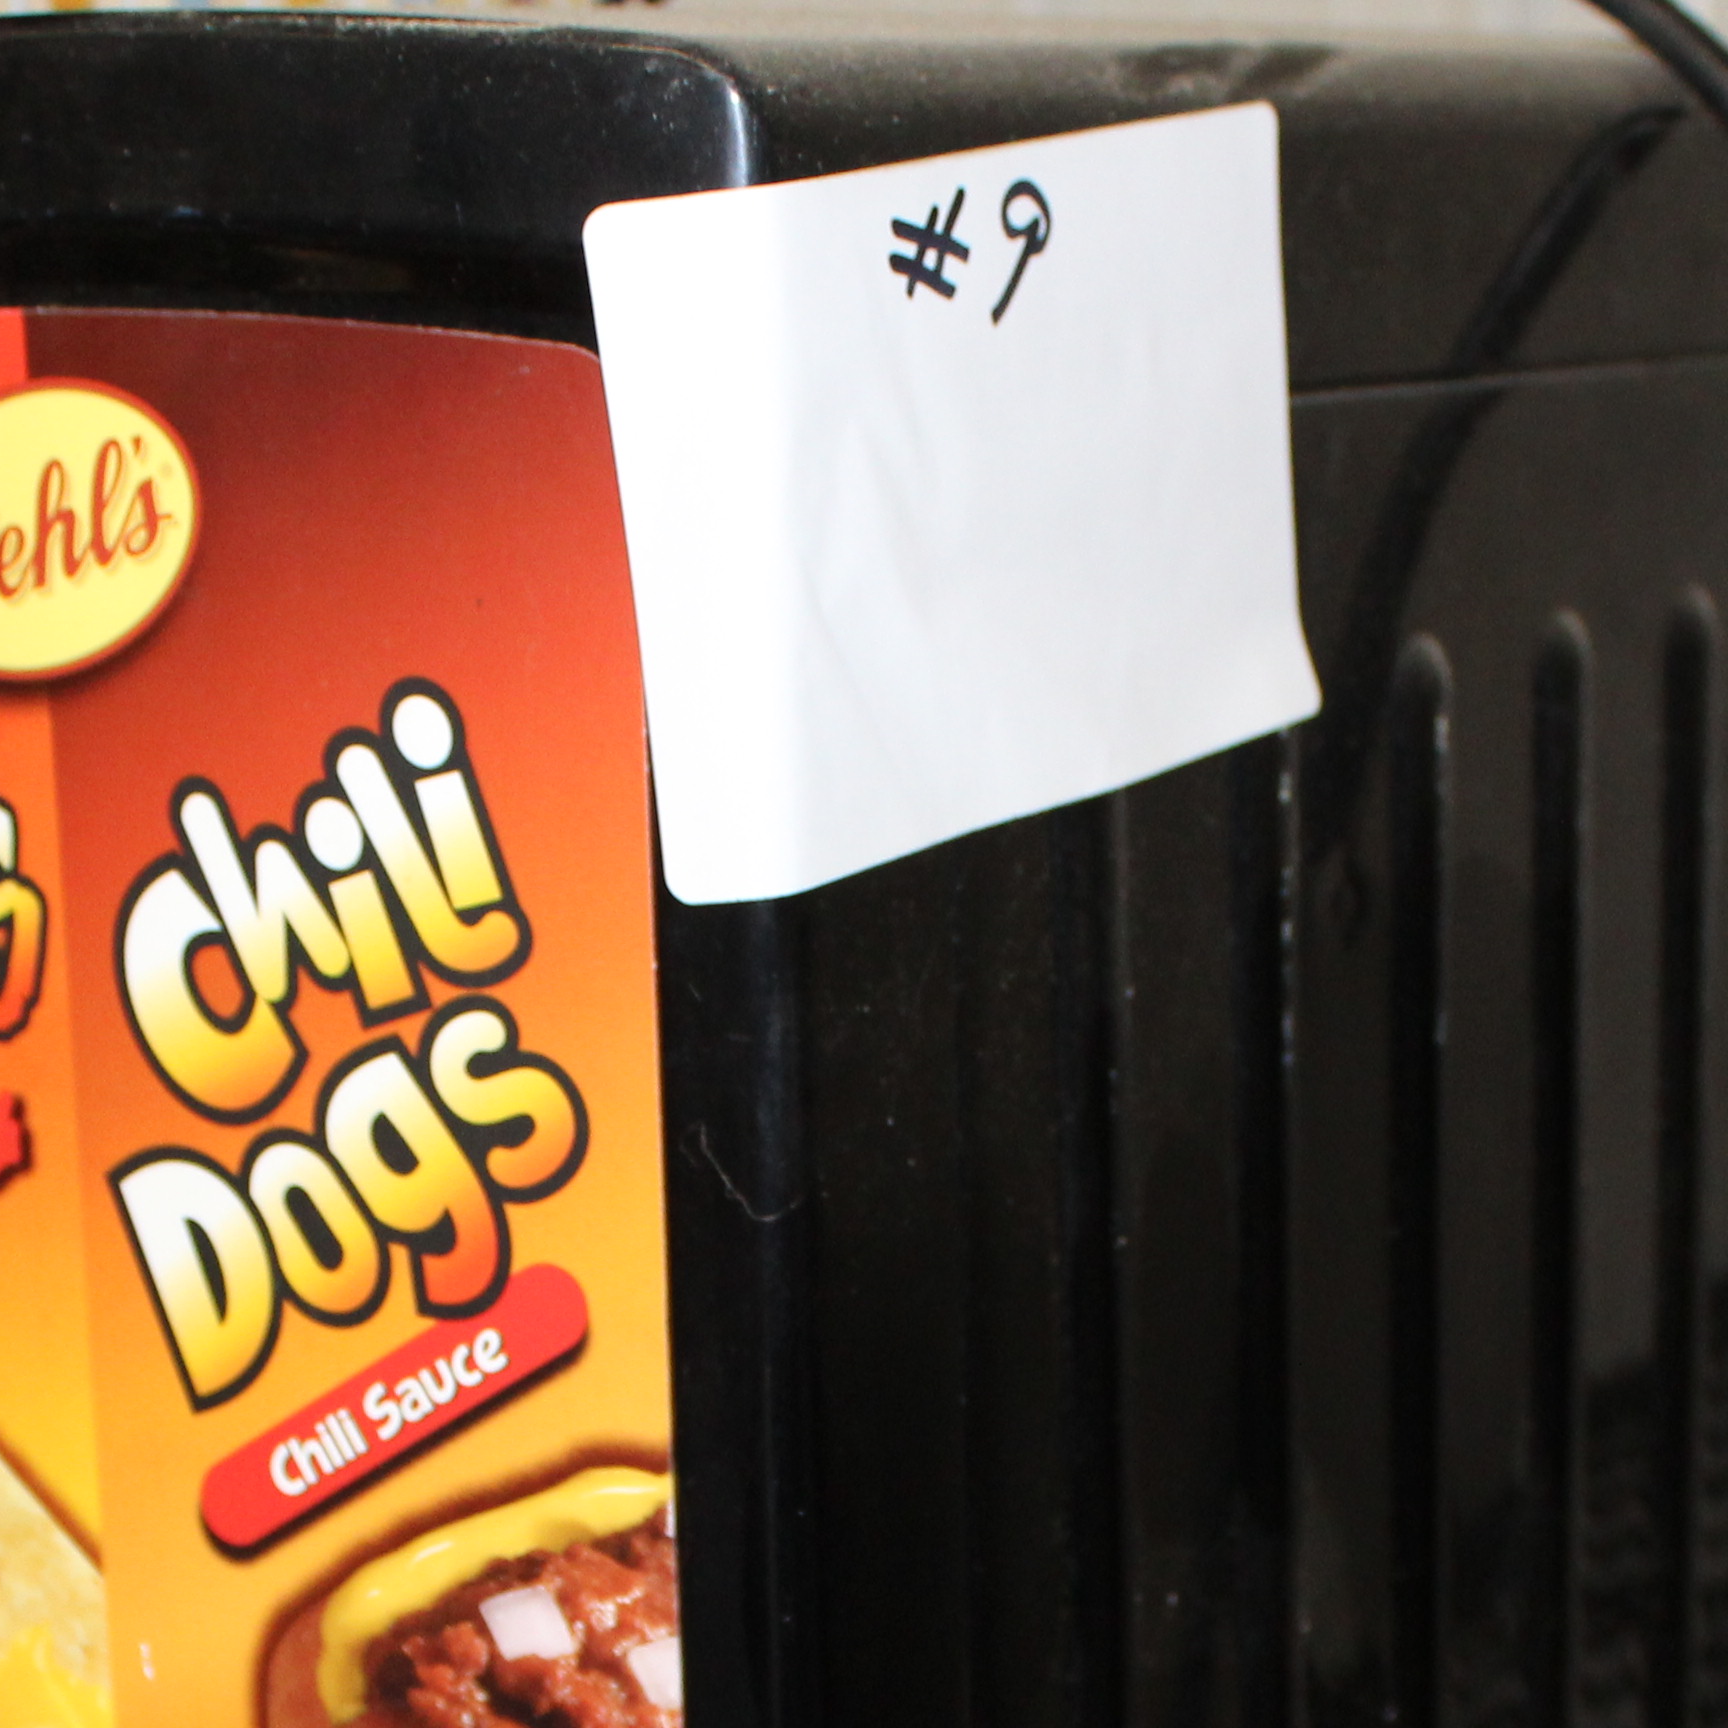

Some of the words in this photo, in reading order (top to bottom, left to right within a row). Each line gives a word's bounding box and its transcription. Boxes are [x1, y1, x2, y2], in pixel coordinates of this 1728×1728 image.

[888, 178, 1052, 327] #9
[117, 678, 531, 1123] Chili
[106, 994, 589, 1412] Dogs
[268, 1405, 368, 1498] Chili
[362, 1325, 511, 1441] Sauce
